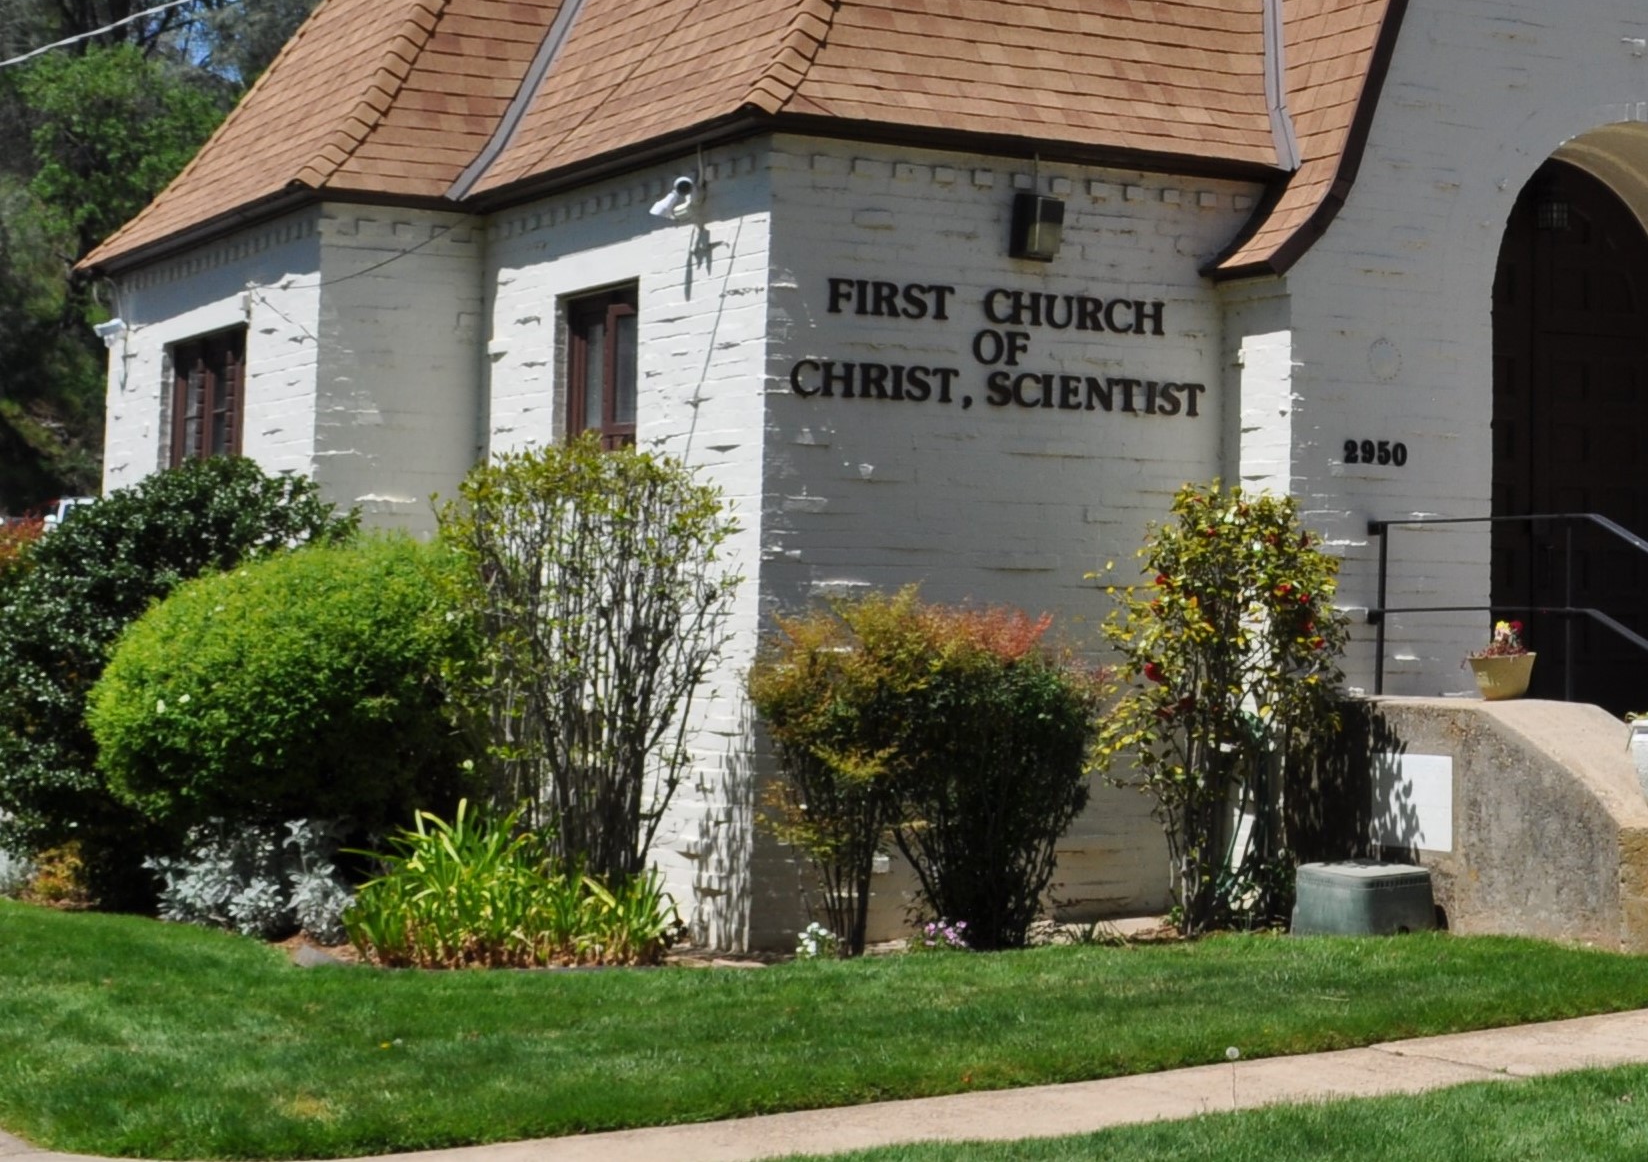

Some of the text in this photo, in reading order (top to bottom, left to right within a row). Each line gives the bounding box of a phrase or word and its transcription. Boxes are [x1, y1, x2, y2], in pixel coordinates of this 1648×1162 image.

[827, 278, 1165, 336] FIRST CHURCH
[972, 329, 1031, 366] OF
[789, 358, 1206, 417] CHRIST, SCIENTIST
[1343, 439, 1408, 468] 2950
